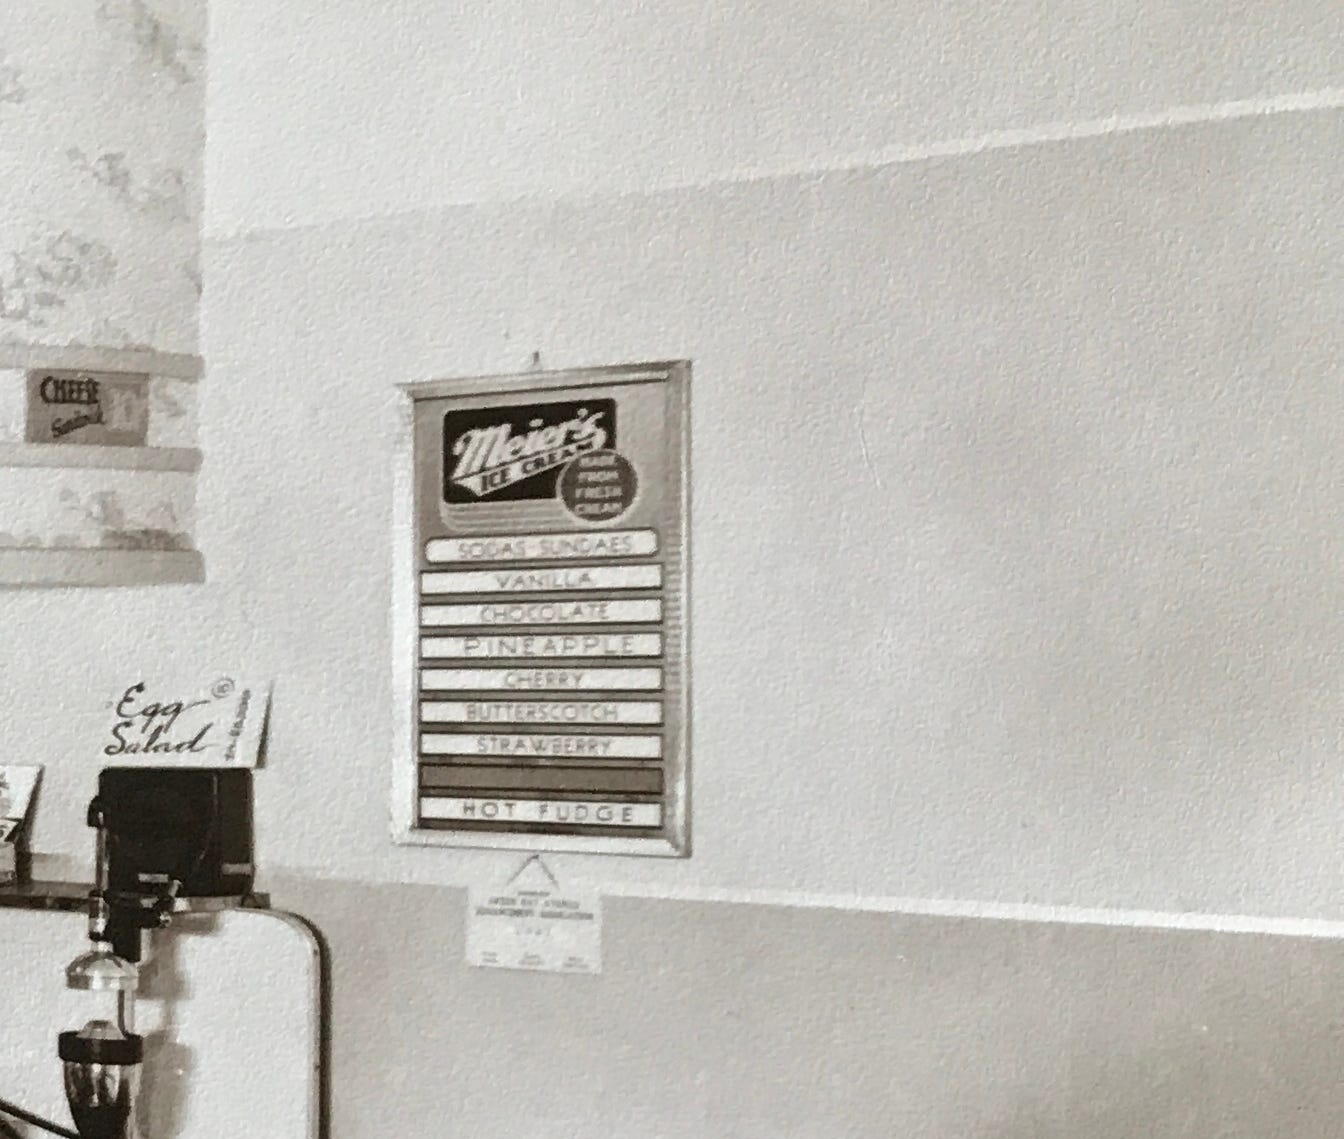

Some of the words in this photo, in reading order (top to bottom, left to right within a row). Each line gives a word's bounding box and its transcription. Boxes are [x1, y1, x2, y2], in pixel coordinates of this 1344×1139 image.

[453, 408, 607, 479] Meier's
[481, 468, 511, 491] ICE
[539, 535, 633, 557] SUNDAES
[496, 572, 592, 589] VANILLA
[480, 603, 610, 622] CHOCOLATE
[464, 636, 634, 655] PINEAPPLE
[504, 672, 584, 689] CHERRY
[116, 681, 209, 734] Egg
[466, 704, 618, 721] BUTTERSCOTCH
[104, 721, 214, 756] Salad
[476, 736, 611, 753] STRAWBERRY
[463, 802, 515, 818] HOT
[539, 804, 633, 822] FUDGE
